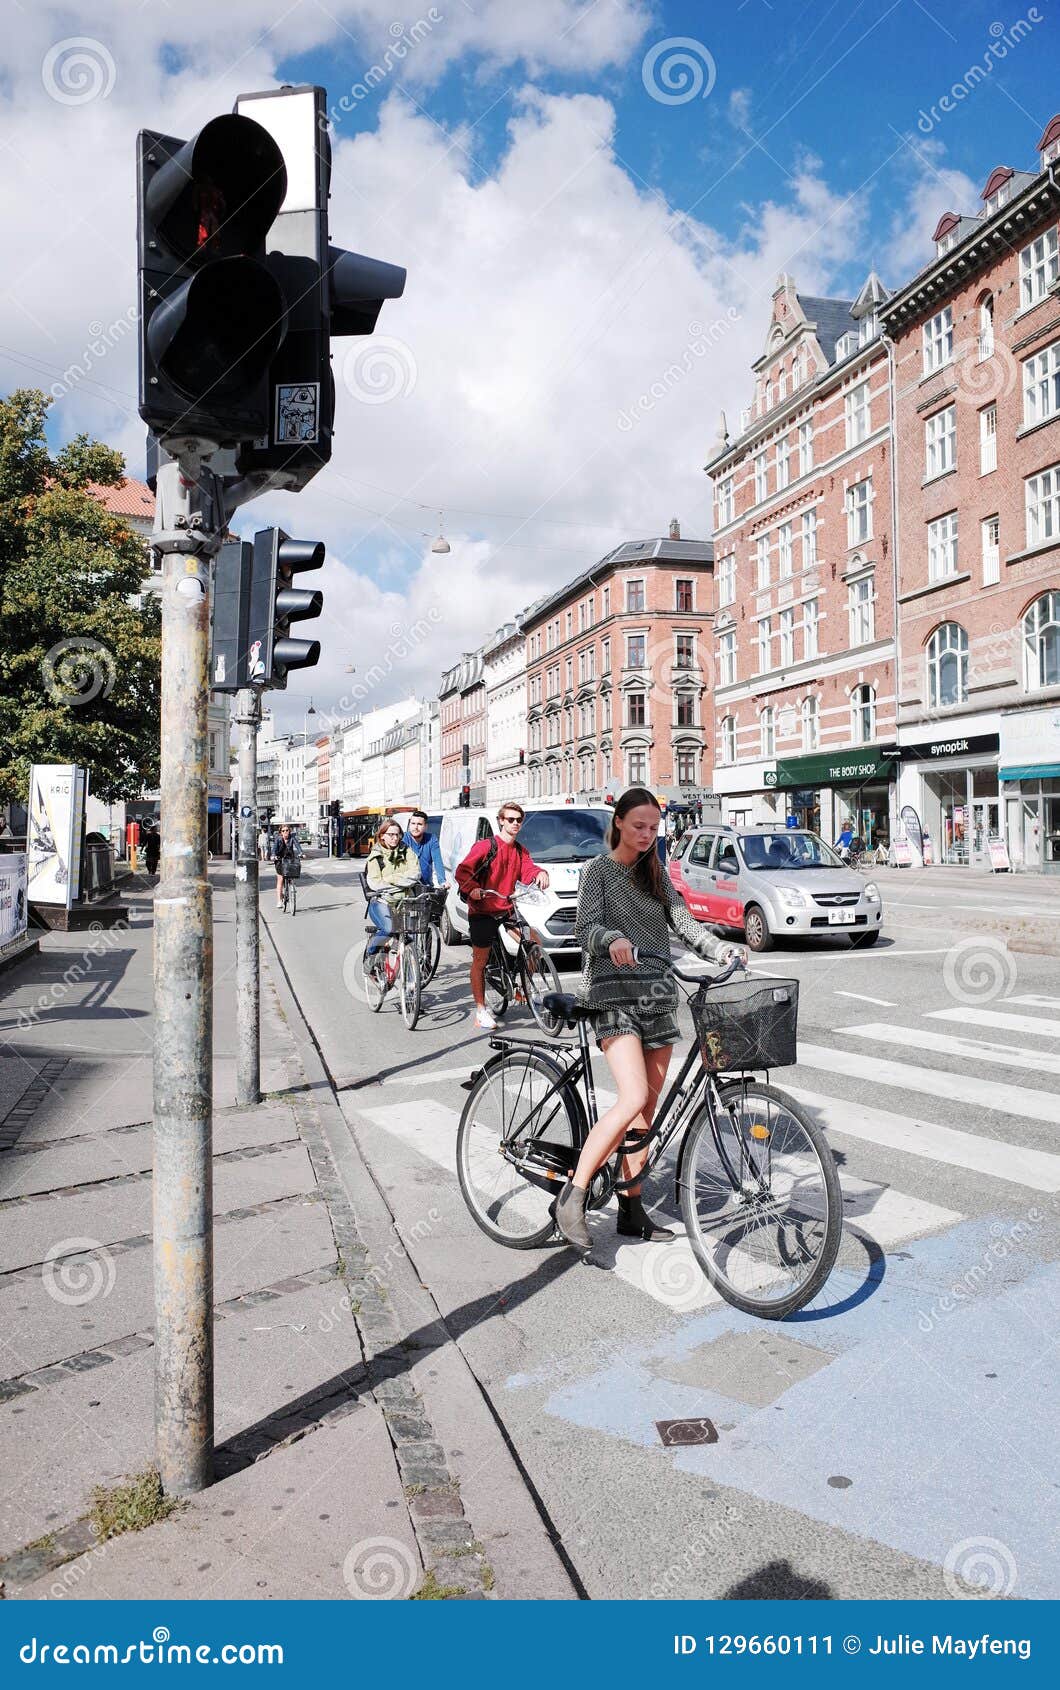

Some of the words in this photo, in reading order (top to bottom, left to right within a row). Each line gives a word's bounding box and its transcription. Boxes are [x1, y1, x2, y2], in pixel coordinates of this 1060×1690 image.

[930, 739, 969, 756] synoptik
[829, 767, 841, 778] THE
[841, 765, 859, 777] BODY
